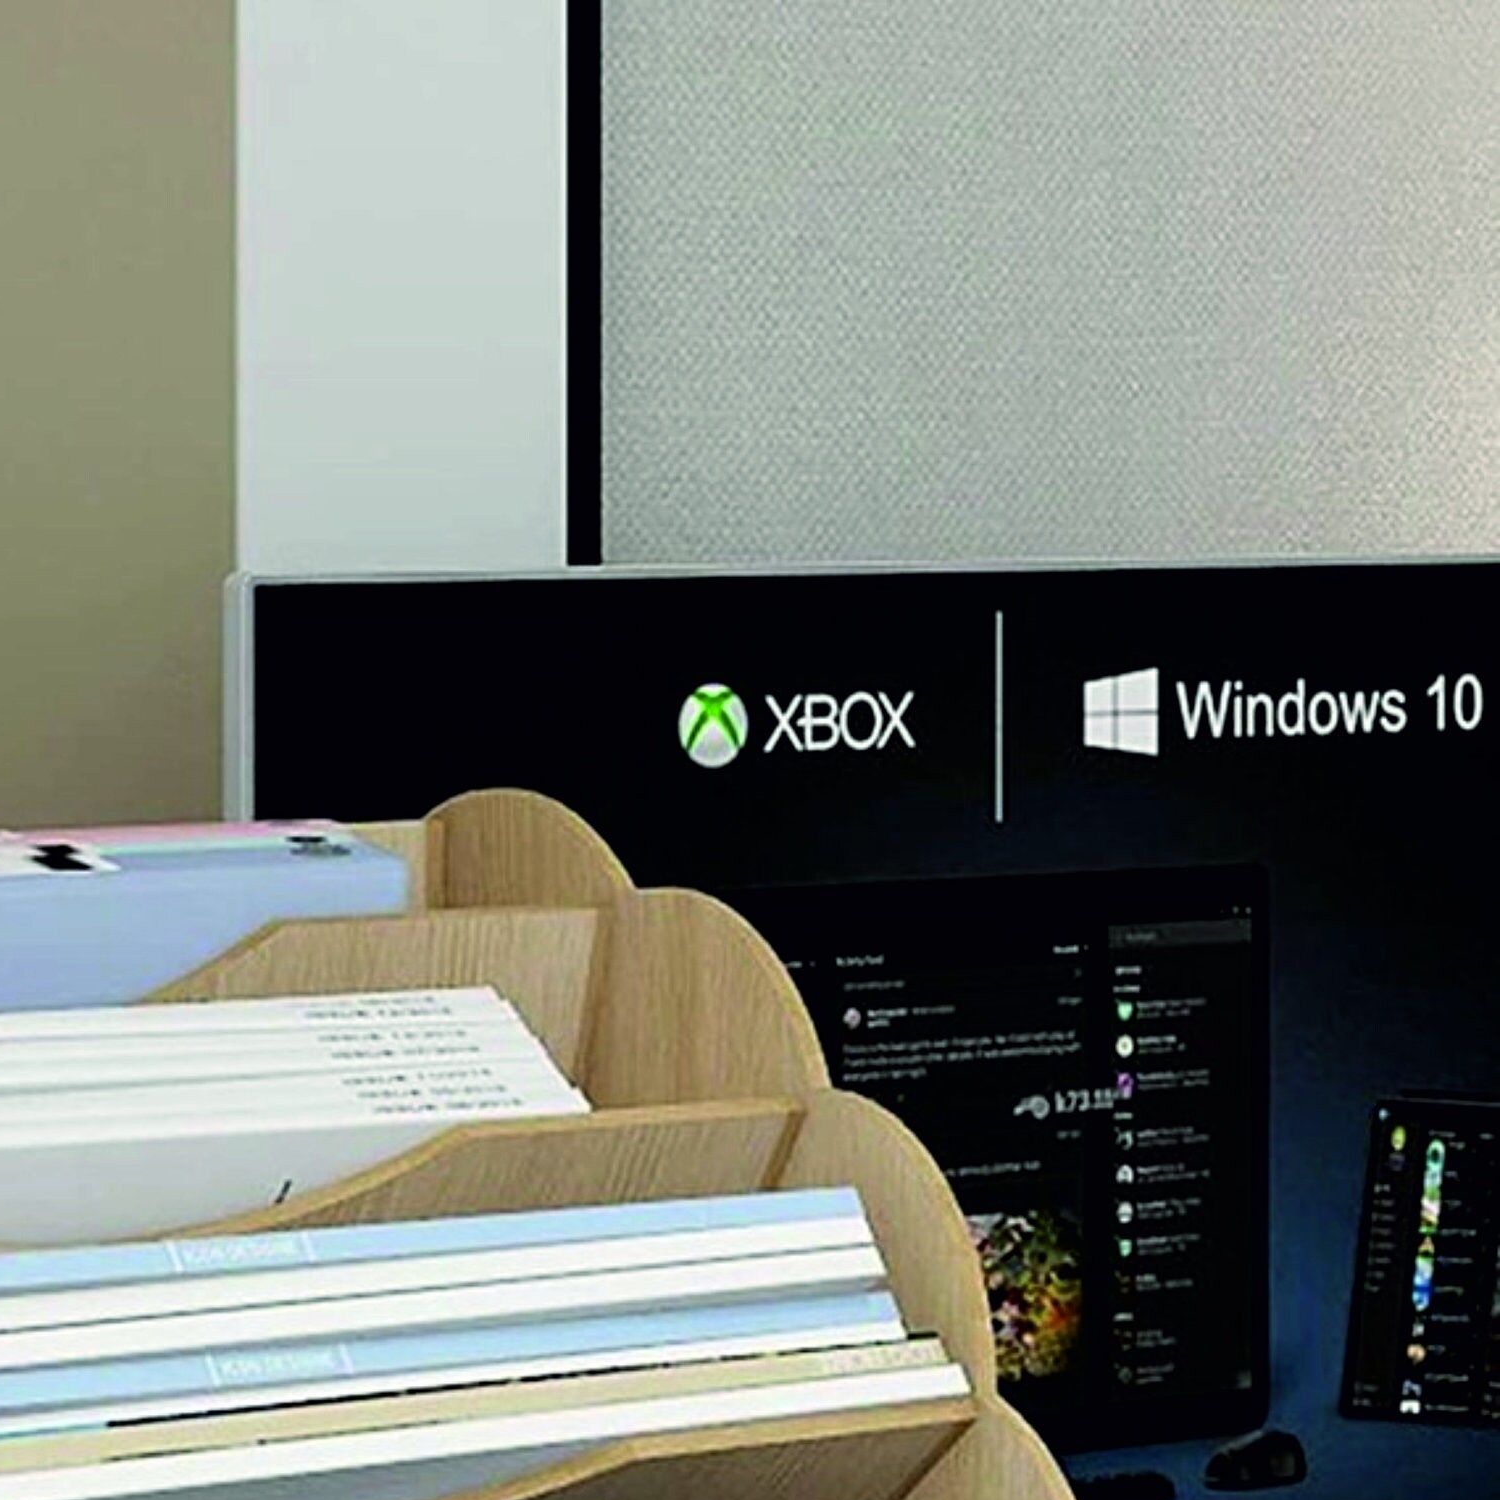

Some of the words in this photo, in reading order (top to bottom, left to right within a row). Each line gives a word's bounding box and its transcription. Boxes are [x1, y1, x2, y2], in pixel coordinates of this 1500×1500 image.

[764, 691, 917, 752] XBOX
[1177, 678, 1407, 740] Windows
[1426, 673, 1484, 731] 10
